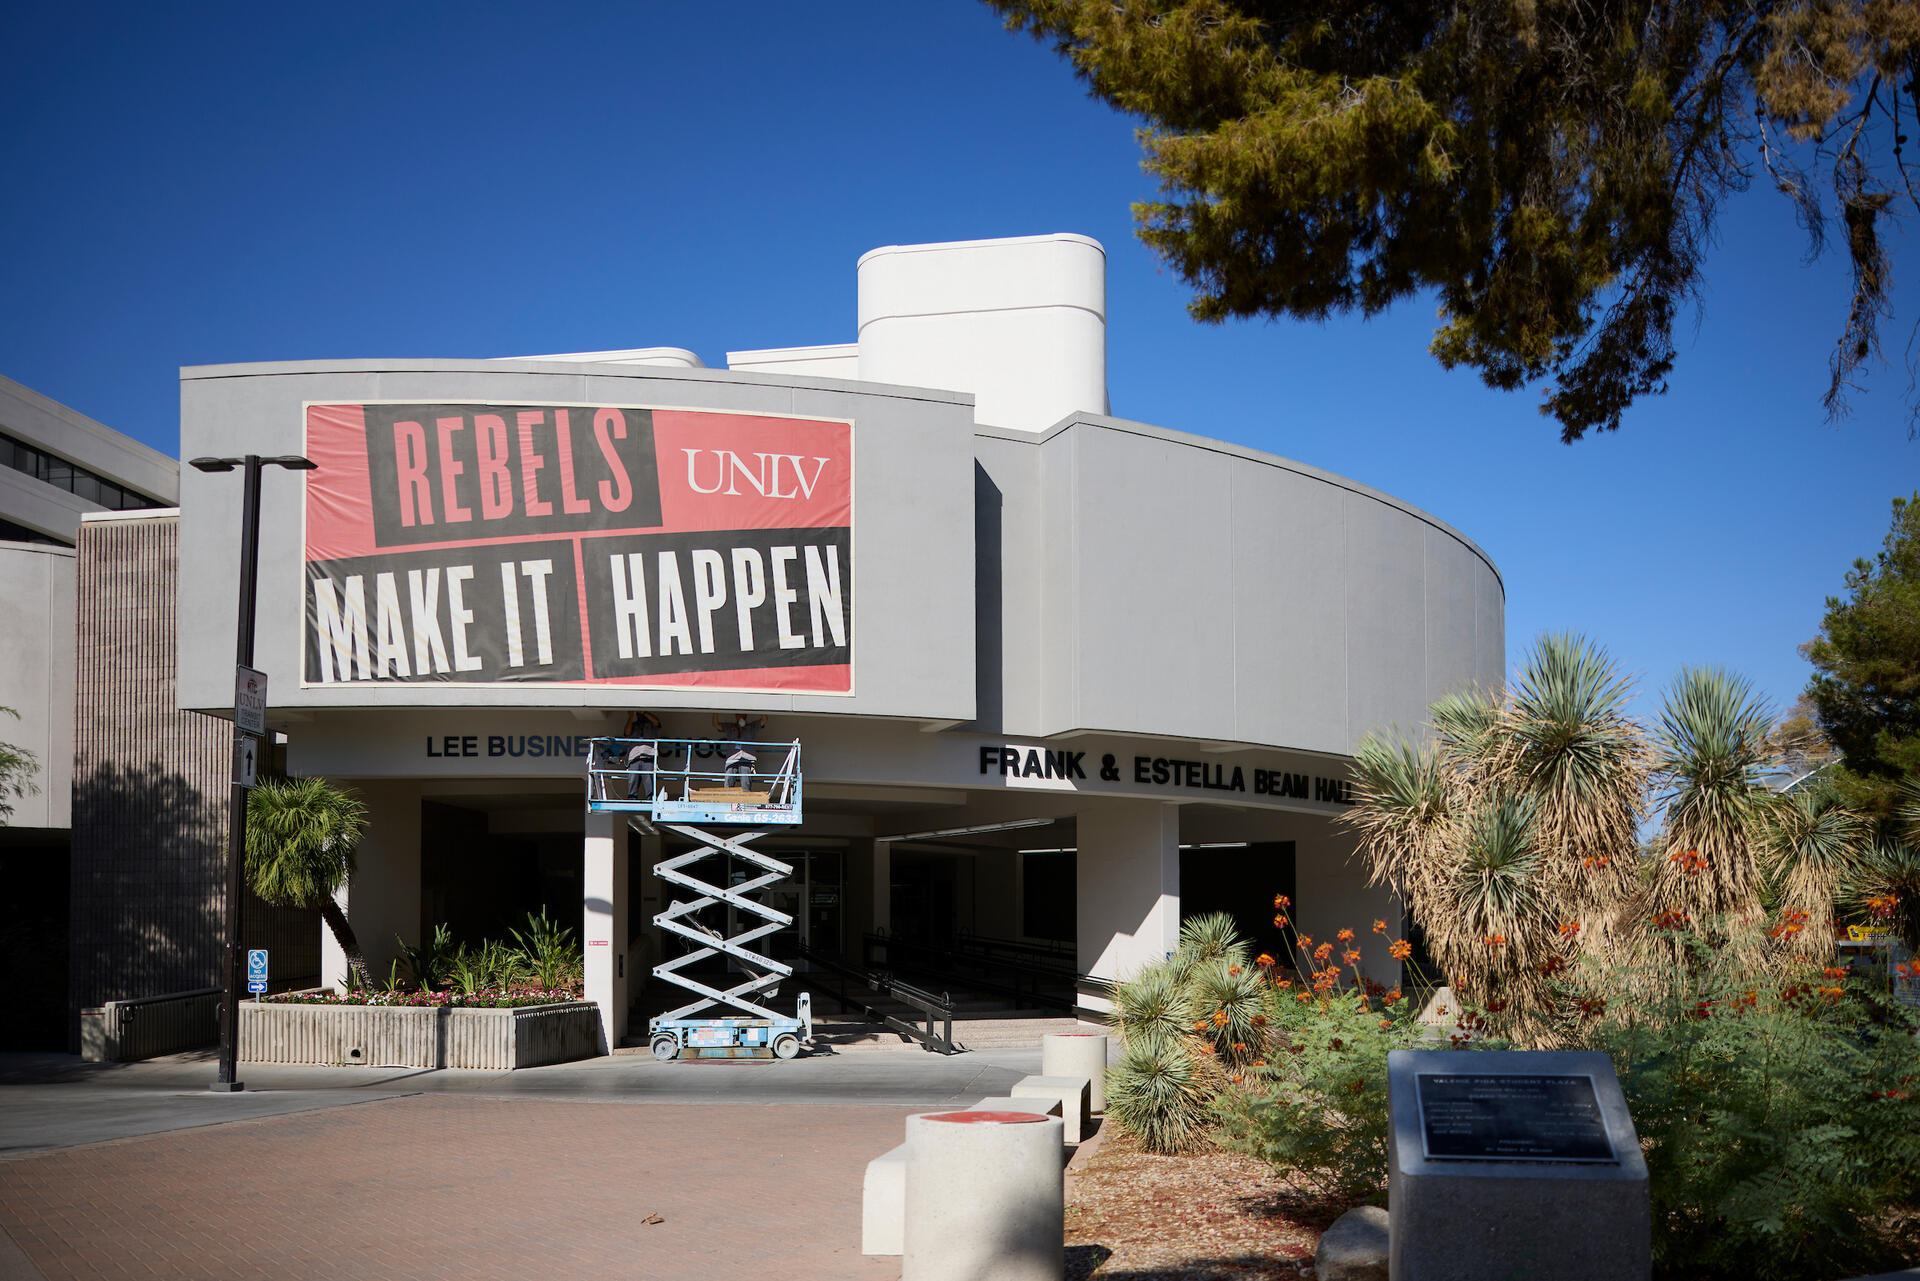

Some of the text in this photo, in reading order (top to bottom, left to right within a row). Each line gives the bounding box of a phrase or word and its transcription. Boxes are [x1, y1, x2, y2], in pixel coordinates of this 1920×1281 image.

[393, 408, 633, 528] REBELS
[680, 448, 831, 500] UNLV
[314, 545, 845, 683] MAKE IT HAPPEN
[239, 692, 264, 711] UNLV
[427, 736, 478, 757] LEE
[979, 747, 1087, 779] FRANK
[1100, 753, 1121, 782] &
[1134, 756, 1246, 792] ESTELLA
[1254, 769, 1309, 799] BEAM
[724, 813, 751, 822] Genie
